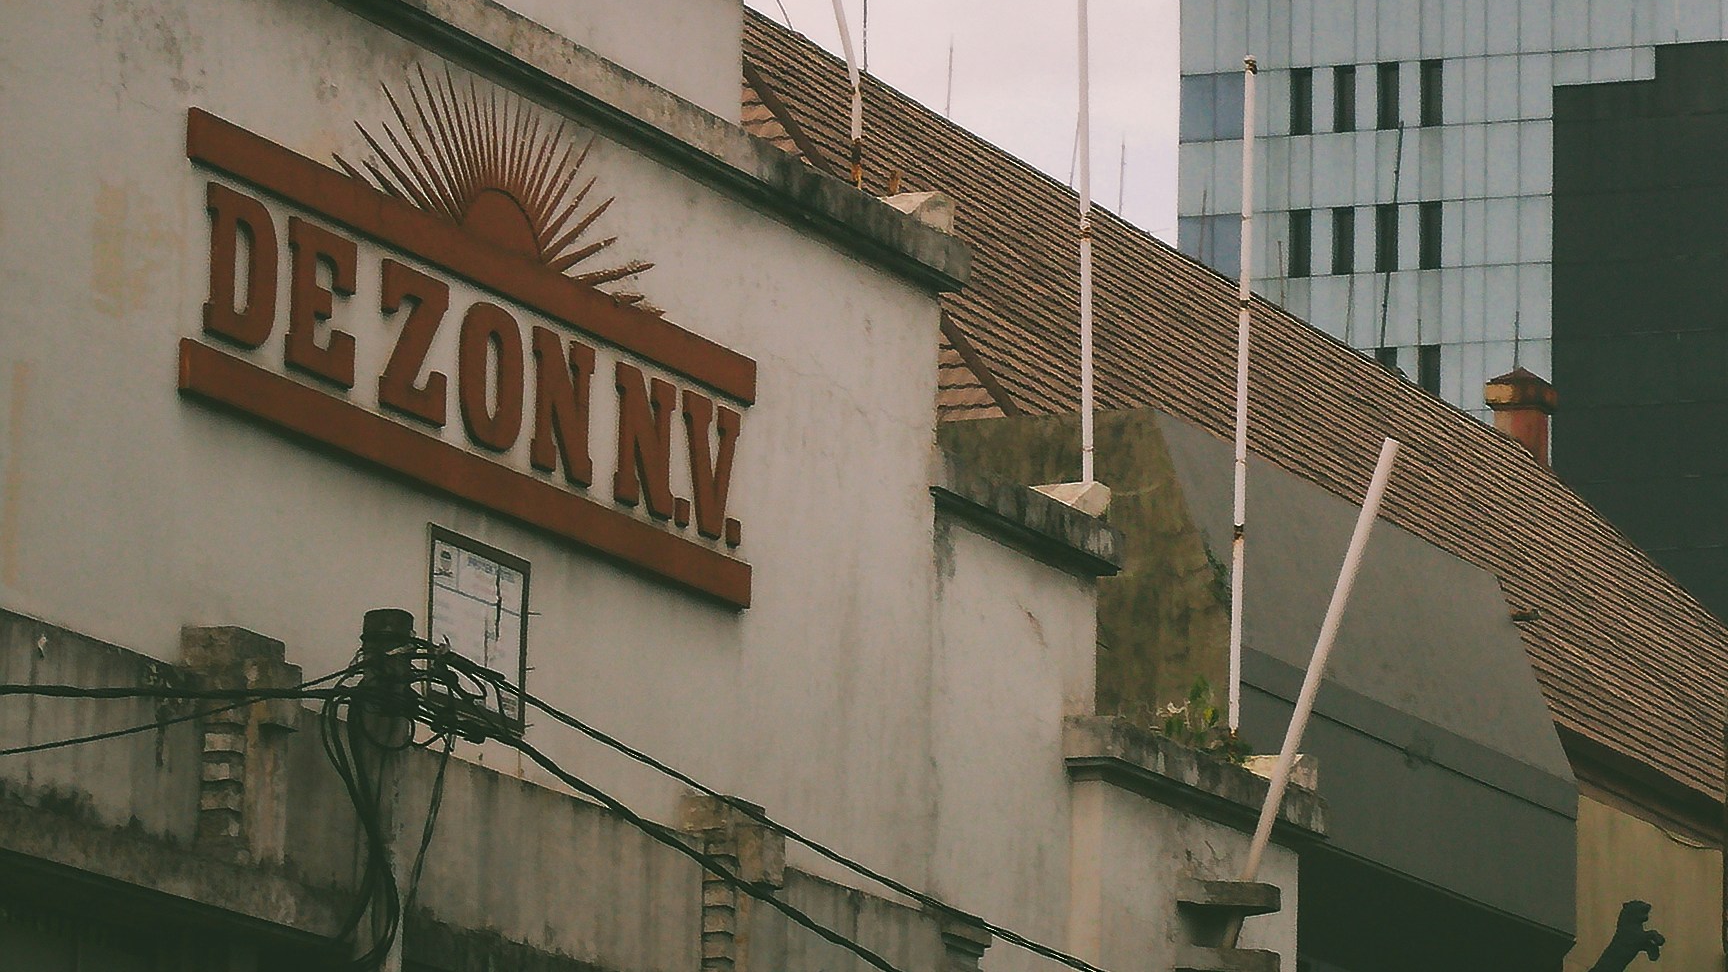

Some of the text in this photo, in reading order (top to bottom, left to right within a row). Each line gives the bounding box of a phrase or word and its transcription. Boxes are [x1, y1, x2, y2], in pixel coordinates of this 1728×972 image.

[203, 181, 742, 549] DE ZON N.V.
